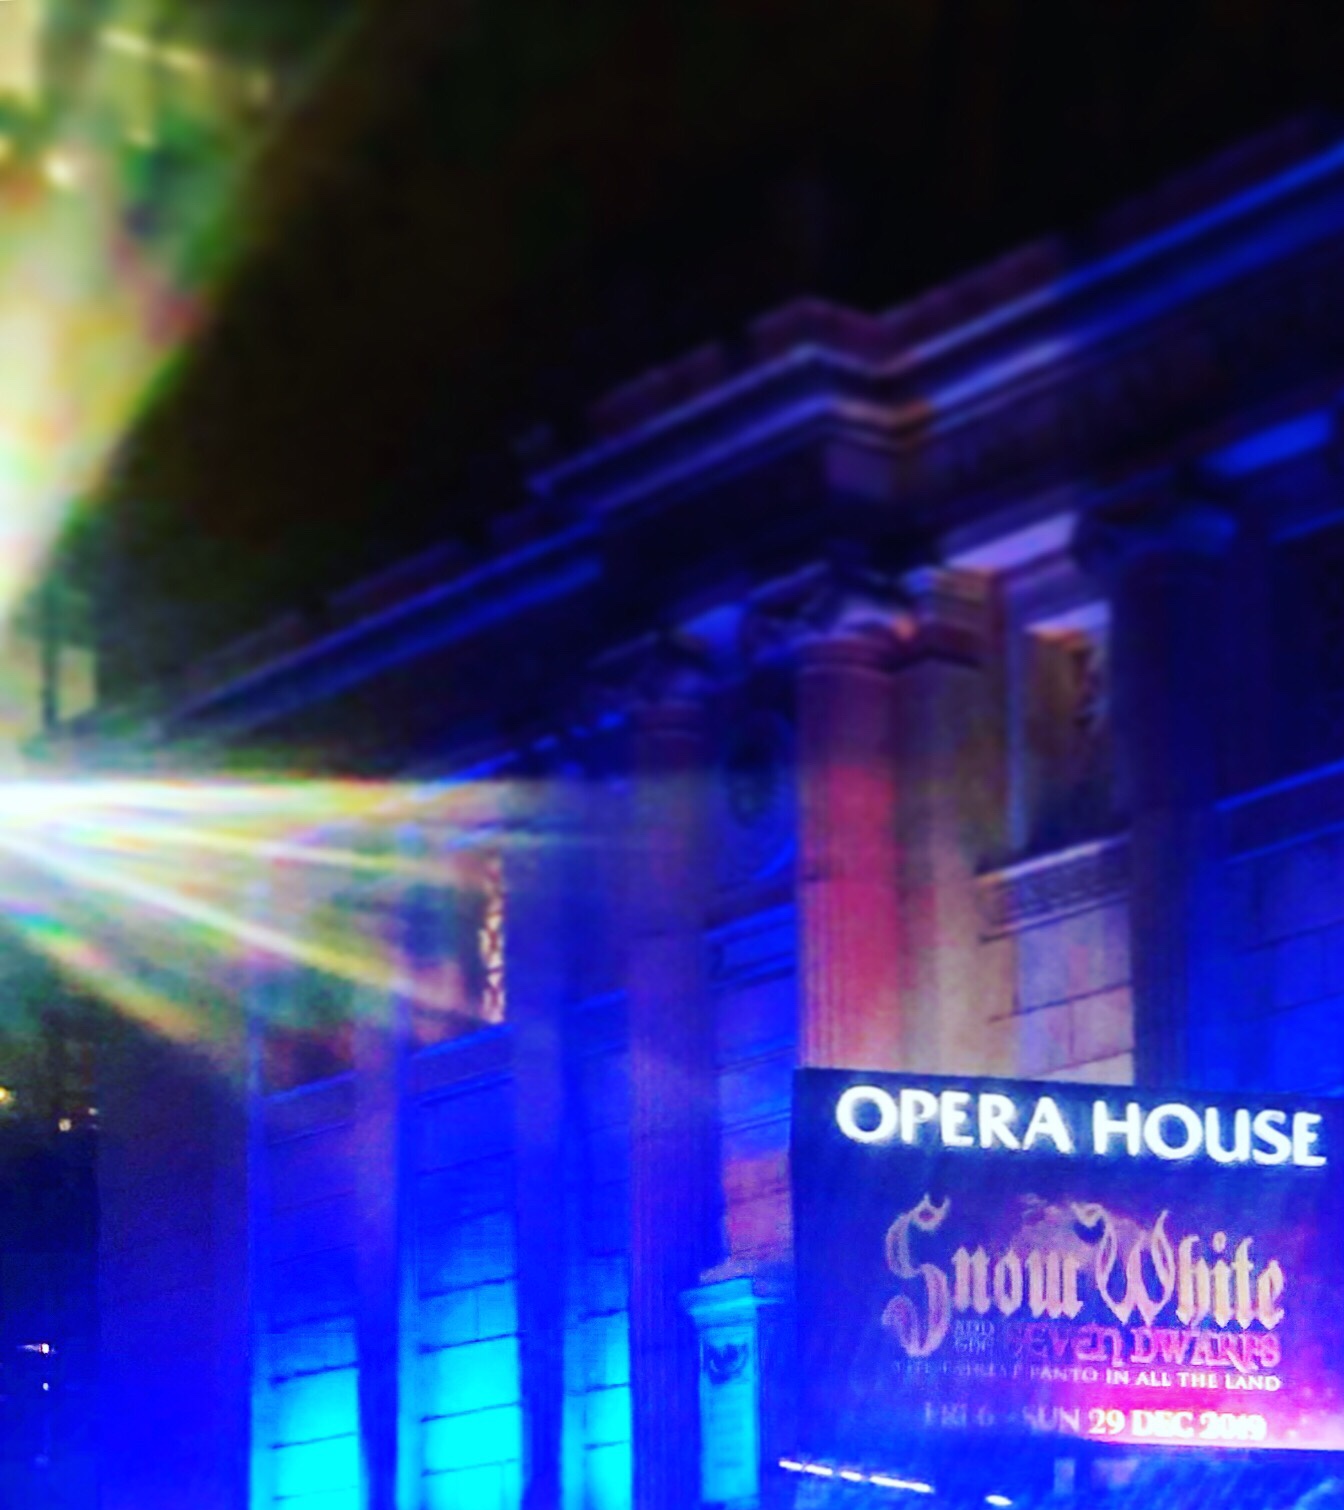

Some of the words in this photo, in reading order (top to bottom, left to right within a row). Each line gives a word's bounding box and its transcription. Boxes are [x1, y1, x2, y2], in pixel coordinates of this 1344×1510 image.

[836, 1085, 1073, 1155] OPERA
[1093, 1099, 1327, 1167] HOUSE
[882, 1193, 1085, 1358] Snow
[1072, 1200, 1286, 1331] White
[1029, 1365, 1099, 1384] PANTO
[1105, 1369, 1129, 1385] IN
[1135, 1371, 1171, 1388] ALL
[1177, 1373, 1218, 1390] THE
[1225, 1375, 1282, 1392] LAND
[1024, 1404, 1081, 1434] SUN
[1088, 1407, 1127, 1435] 29
[1131, 1410, 1195, 1439] DEC
[1198, 1411, 1267, 1442] 2019
